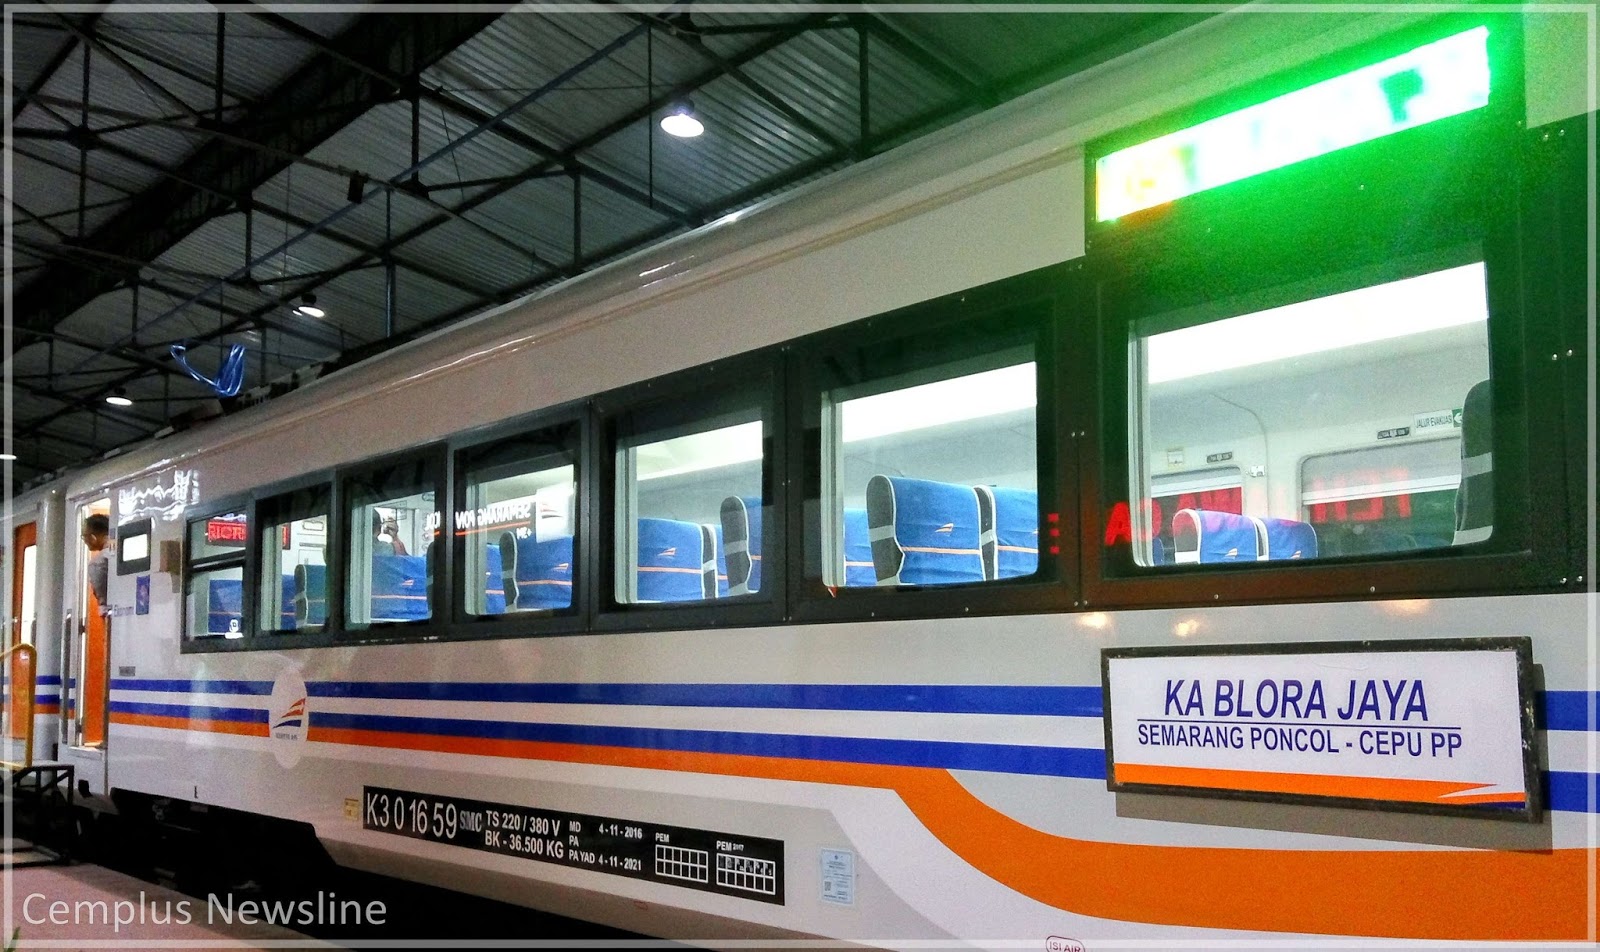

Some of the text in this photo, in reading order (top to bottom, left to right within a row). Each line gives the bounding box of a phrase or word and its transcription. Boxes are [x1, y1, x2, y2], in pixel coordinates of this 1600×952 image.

[1164, 679, 1429, 722] KA BLORA JAYA
[1138, 723, 1244, 750] SEMARANG
[1250, 726, 1340, 754] PONCOL
[1359, 730, 1422, 757] CEPU
[1431, 732, 1463, 758] PP
[459, 810, 483, 833] SMC
[486, 810, 500, 828] TS
[501, 812, 521, 831] 220
[529, 816, 549, 836] 380
[551, 819, 561, 837] V
[569, 821, 582, 833] MD
[485, 830, 500, 848] BK
[509, 833, 543, 855] 36.500
[546, 841, 564, 859] KG
[569, 835, 579, 847] PA
[655, 832, 670, 843] PEM
[716, 840, 732, 851] PEM
[569, 849, 579, 862] PA
[579, 851, 596, 864] YAD
[1049, 941, 1062, 951] ISI
